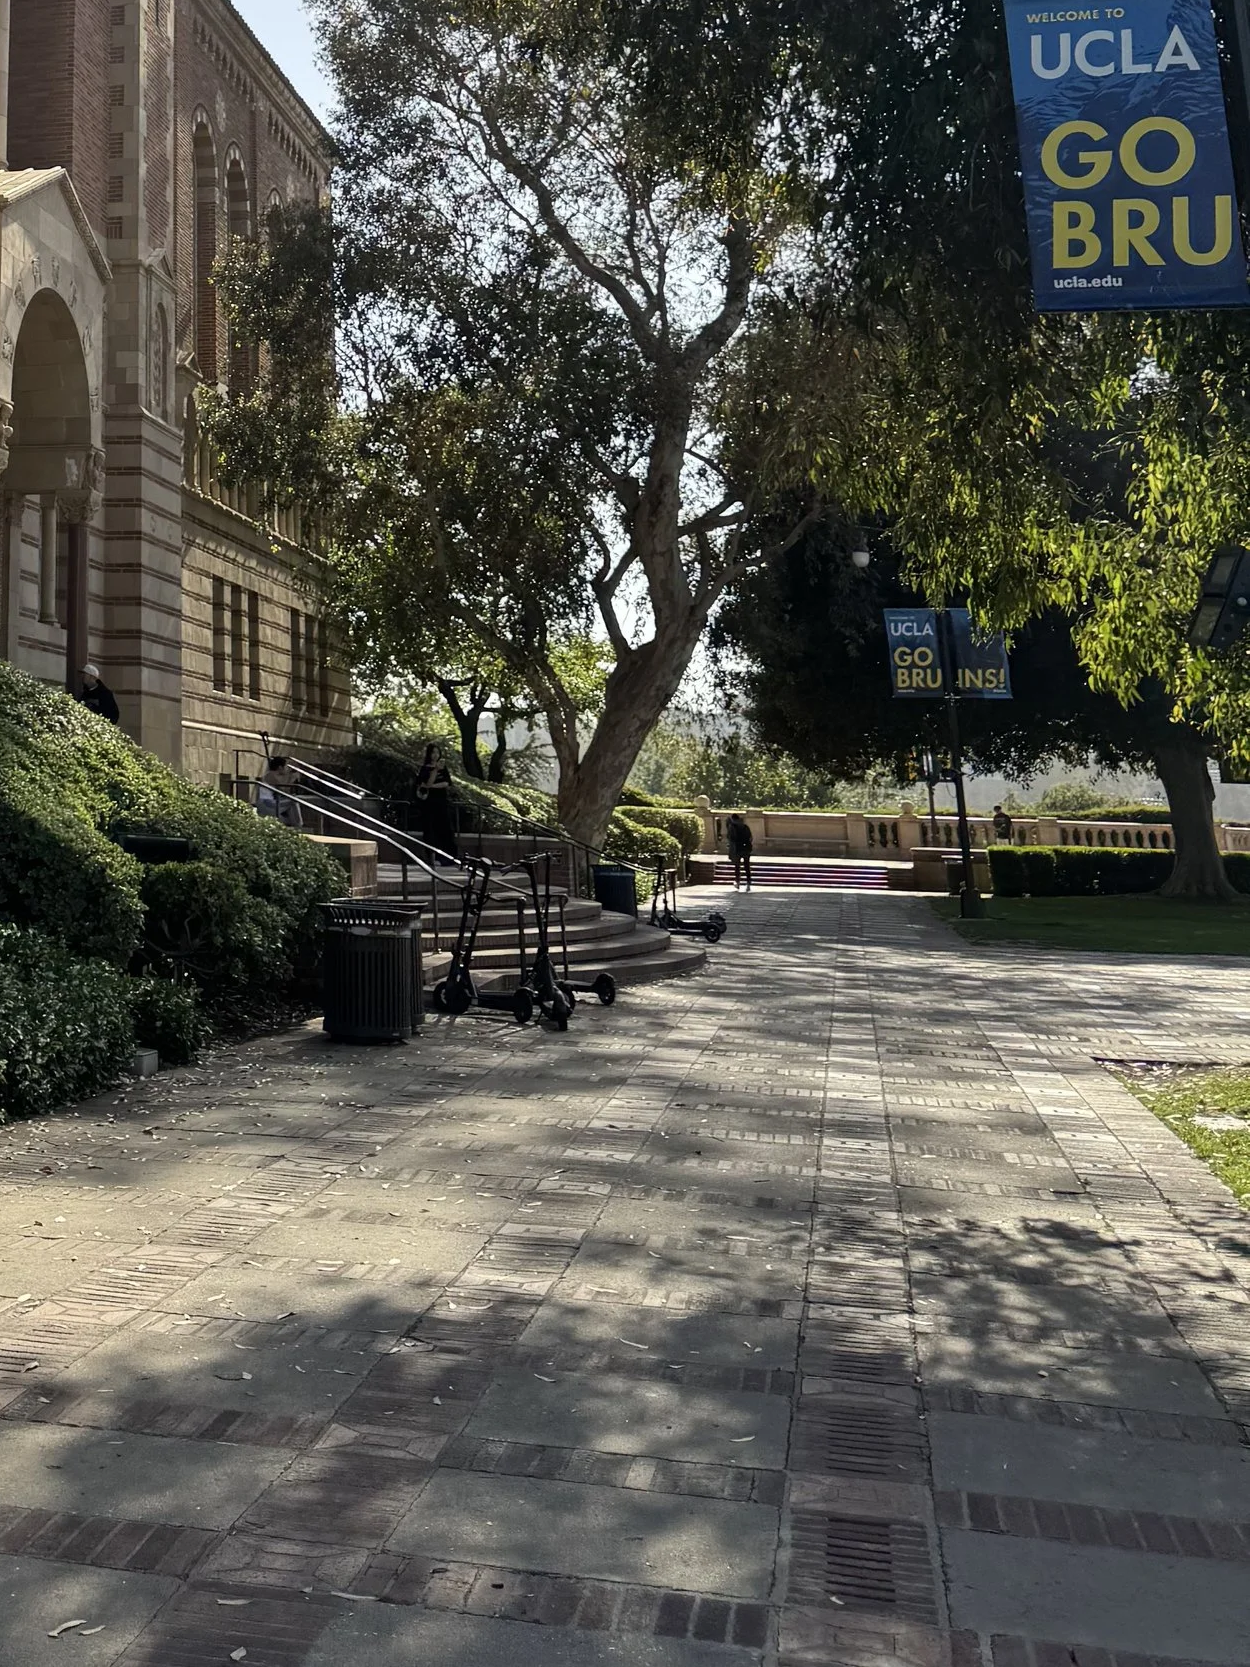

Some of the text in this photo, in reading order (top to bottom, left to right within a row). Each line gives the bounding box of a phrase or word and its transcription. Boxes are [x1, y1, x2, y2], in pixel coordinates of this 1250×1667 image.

[1026, 8, 1125, 24] WELCOME TO
[1030, 24, 1201, 79] UCLA
[1041, 116, 1196, 190] GO
[1052, 195, 1233, 269] BRU
[1053, 275, 1123, 289] ucla.edu
[890, 622, 934, 636] UCLA
[893, 646, 934, 667] GO
[897, 668, 943, 688] BRU
[957, 668, 1005, 688] INS!
